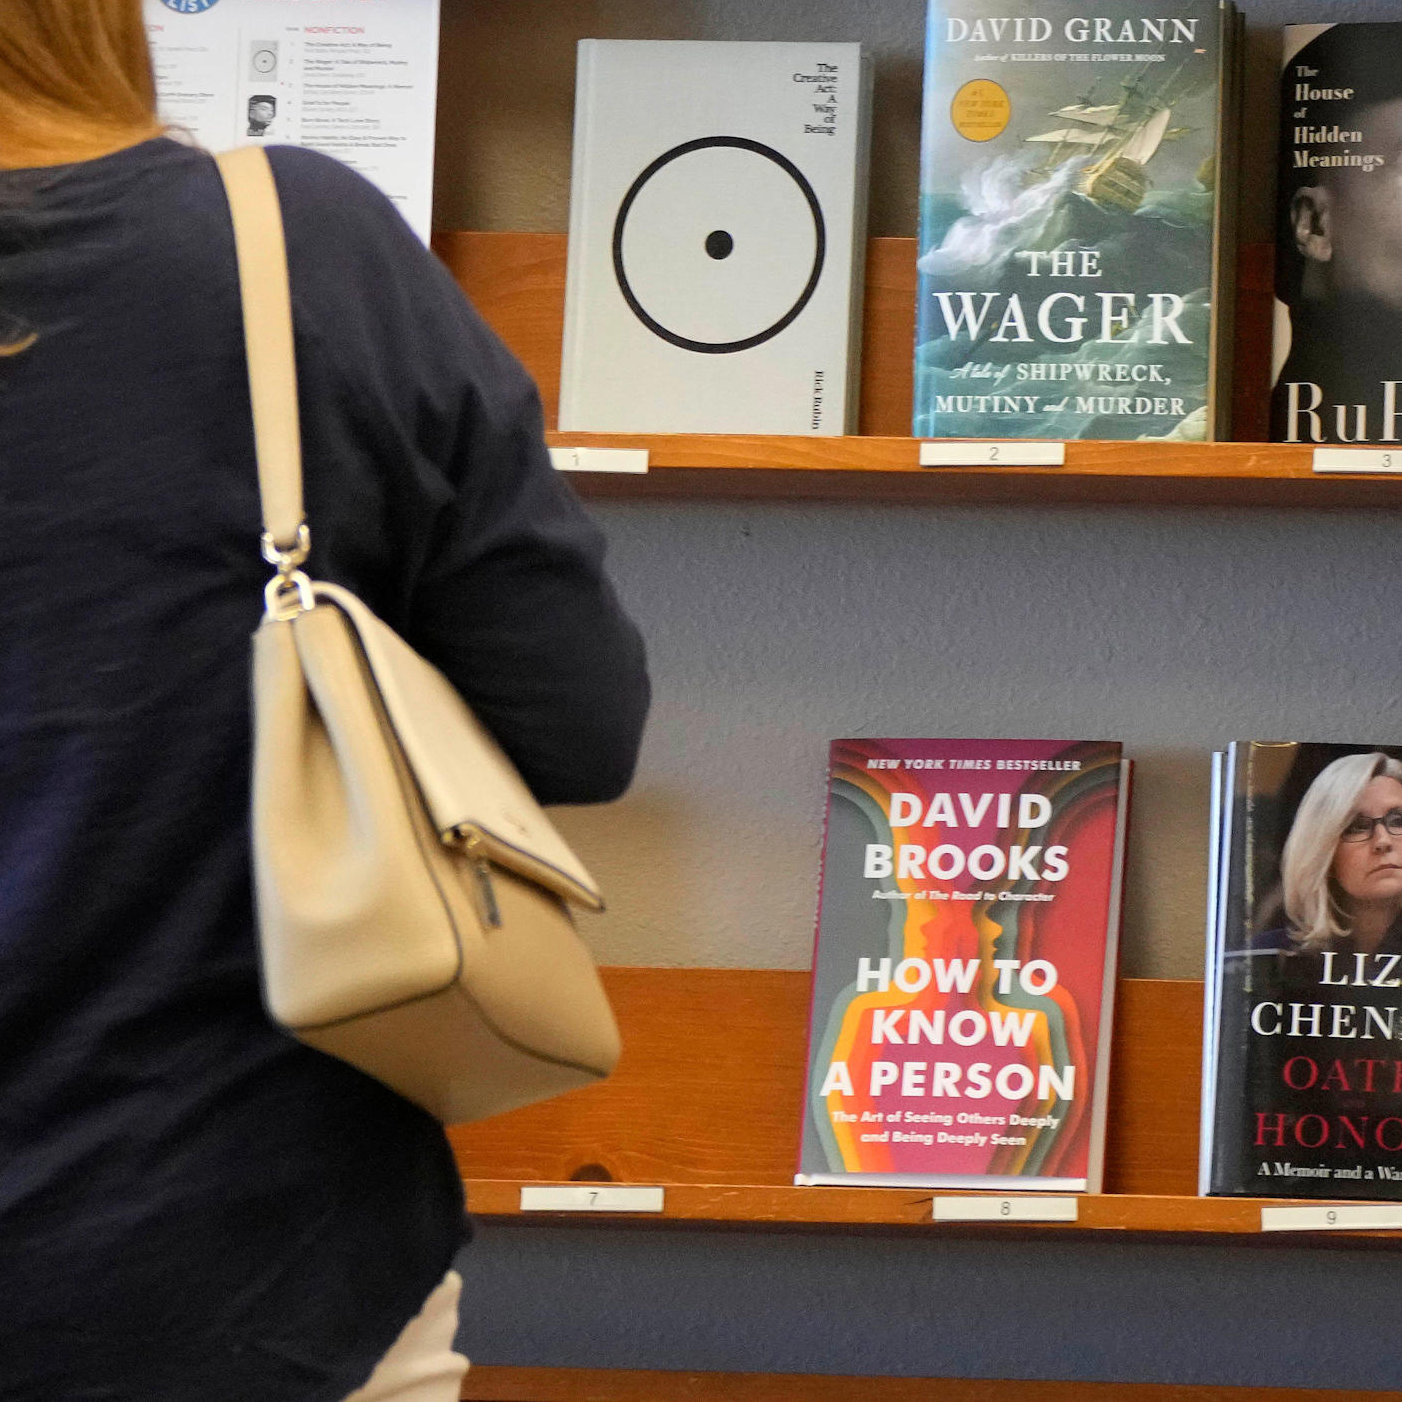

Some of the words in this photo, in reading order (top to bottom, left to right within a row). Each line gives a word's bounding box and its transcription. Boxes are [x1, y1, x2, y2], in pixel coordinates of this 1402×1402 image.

[946, 18, 1052, 44] DAVID
[1065, 18, 1199, 44] GRANN
[793, 74, 838, 84] Creative
[1295, 84, 1354, 101] House
[1294, 126, 1363, 145] Hidden
[1294, 151, 1385, 170] Meanings
[1025, 251, 1104, 278] THE
[932, 292, 1193, 345] WAGER
[867, 759, 900, 769] NEW
[904, 759, 945, 770] YORK
[949, 759, 991, 770] TIMES
[996, 759, 1082, 771] BESTSELLER
[889, 792, 1053, 829] DAVID
[864, 844, 1070, 882] BROOKS
[856, 957, 981, 994] HOW
[992, 960, 1057, 995] TO
[870, 1010, 1036, 1046] KNOW
[819, 1061, 853, 1097] A
[869, 1062, 1076, 1101] PERSON
[833, 1111, 857, 1122] The
[860, 1111, 883, 1122] Art
[886, 1111, 902, 1122] of
[904, 1111, 953, 1125] Seeing
[957, 1112, 1006, 1125] Others
[1009, 1114, 1060, 1129] Deeply
